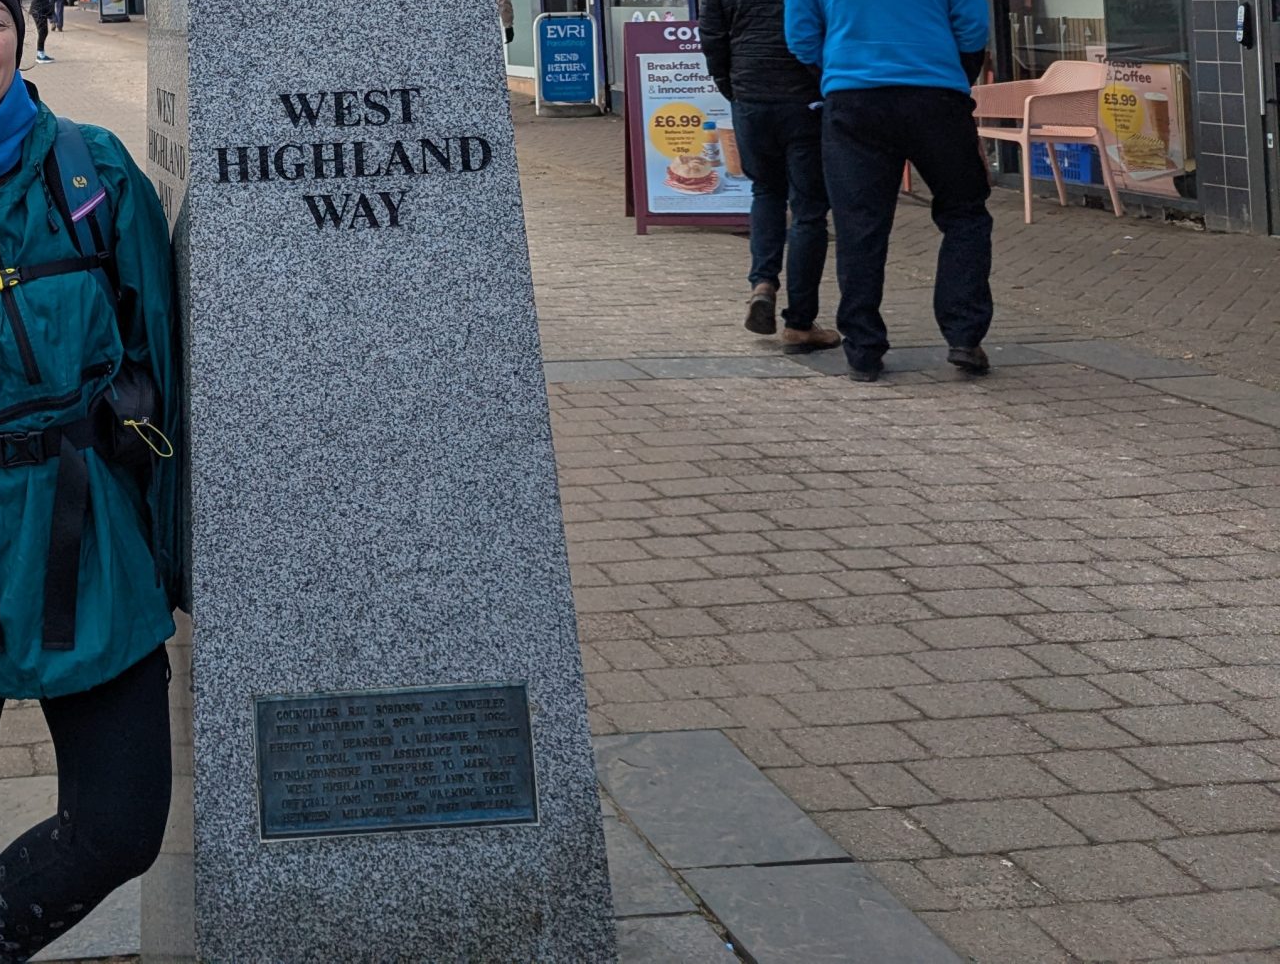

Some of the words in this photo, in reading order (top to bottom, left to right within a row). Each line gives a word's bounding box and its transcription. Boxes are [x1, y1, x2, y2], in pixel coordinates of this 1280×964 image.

[546, 24, 586, 38] EVRi
[554, 52, 579, 62] SEND
[647, 61, 700, 71] Breakfast
[545, 73, 590, 82] COLLECT
[548, 63, 587, 72] RETURN
[1114, 70, 1152, 84] Coffee
[648, 74, 672, 84] Bap,
[674, 73, 712, 82] Coffee
[648, 85, 656, 95] &
[657, 84, 706, 94] innocent
[1104, 92, 1137, 107] £5.99
[156, 86, 176, 127] WEST
[278, 88, 420, 128] WEST
[654, 115, 701, 128] £6.99
[148, 128, 186, 181] HIGHLAND
[213, 136, 493, 184] HIGHLAND
[302, 190, 407, 230] WAY
[276, 707, 339, 721] COUNCILLOR
[455, 698, 506, 710] UNVEILED
[276, 723, 299, 735] THIS
[307, 720, 365, 734] MONUMENT
[373, 718, 385, 729] ON
[423, 713, 476, 726] NOVEMBER
[268, 741, 315, 753] ERECTED
[322, 739, 336, 750] BY
[343, 736, 394, 749] BEARSDEN
[416, 731, 469, 744] MILNGAVIE
[477, 727, 520, 740] DISTRICT
[306, 753, 350, 764] COUNCIL
[355, 751, 381, 761] WITH
[393, 746, 452, 759] ASSISTANCE
[370, 762, 434, 775] ENTERPRISE
[441, 759, 454, 770] TO
[463, 758, 491, 769] MARK
[497, 755, 517, 766] THE
[285, 783, 313, 794] WEST
[322, 780, 375, 793] HIGHLAND
[414, 773, 475, 786] SCOTLAND'S
[482, 771, 511, 782] FIRST
[282, 797, 328, 809] OFFICIAL
[335, 794, 361, 805] LONG
[373, 791, 419, 804] DISTANCE
[429, 787, 478, 799] WALKING
[485, 784, 517, 796] ROUTE
[282, 811, 331, 823] BETWEEN
[342, 807, 397, 820] MILNGAVIE
[407, 804, 427, 814] AND
[436, 802, 460, 813] FORT
[471, 799, 514, 810] WILLIAM
